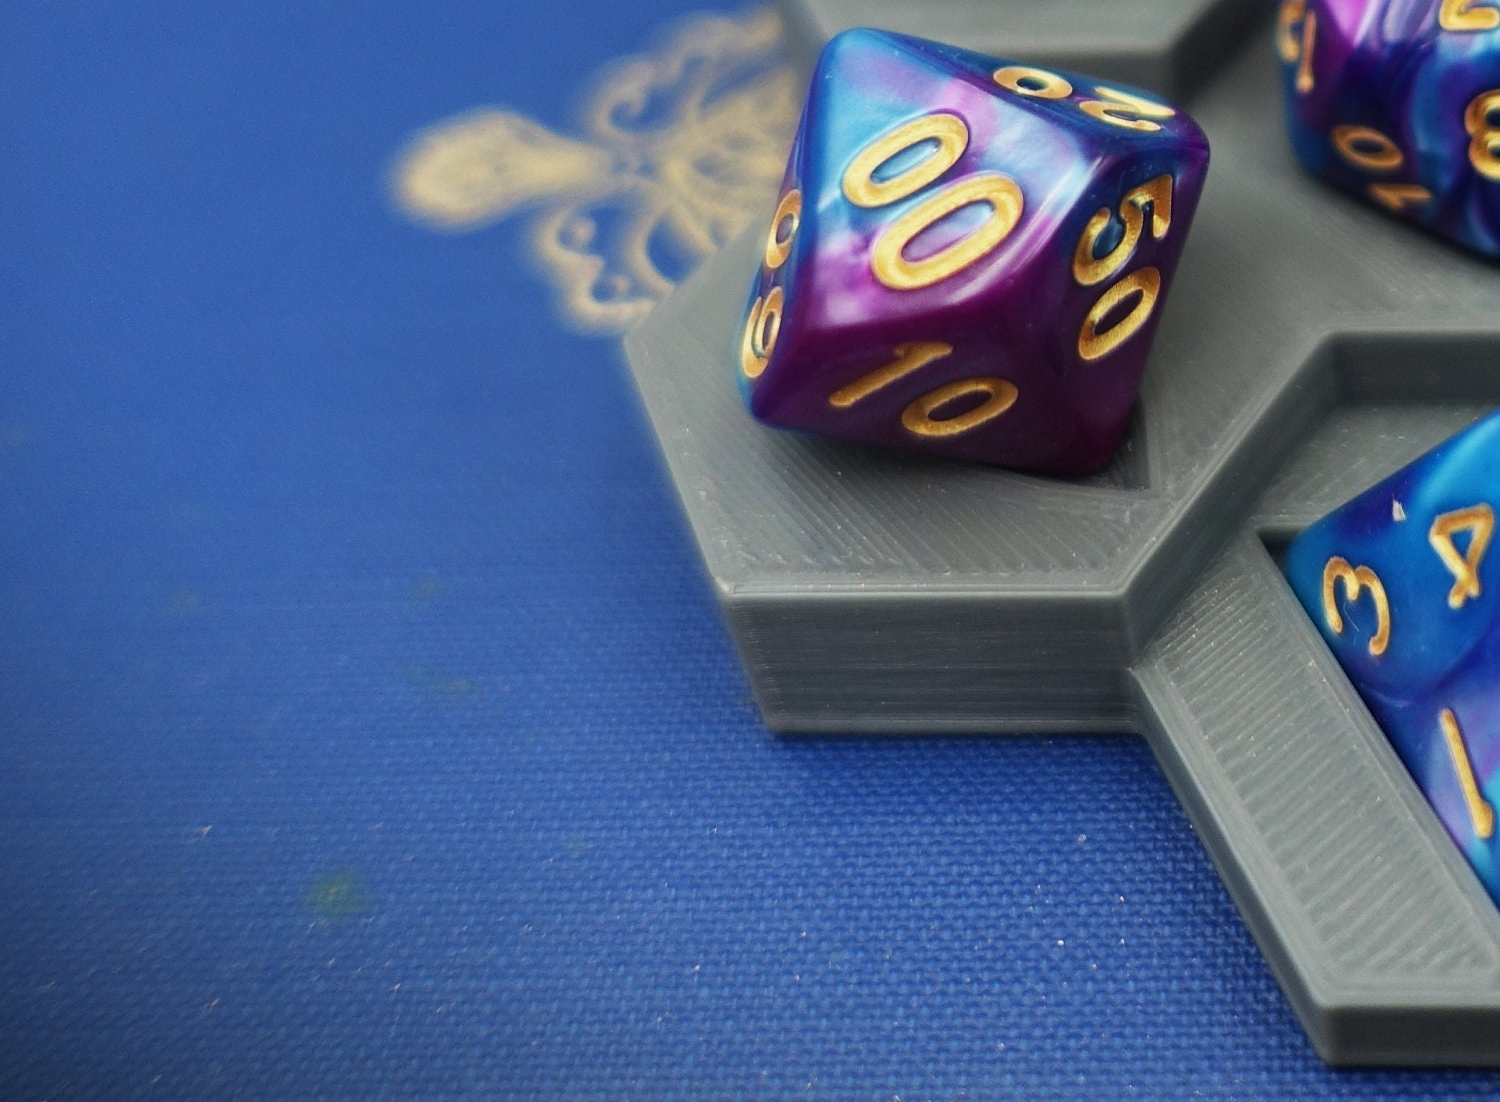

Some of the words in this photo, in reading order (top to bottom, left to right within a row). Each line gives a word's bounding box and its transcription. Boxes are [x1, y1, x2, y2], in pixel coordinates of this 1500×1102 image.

[993, 66, 1176, 132] 20
[842, 111, 1024, 291] 00
[1073, 174, 1173, 362] 50
[828, 341, 1020, 437] 10
[1323, 556, 1389, 656] 3
[1429, 503, 1494, 609] 4
[1440, 706, 1493, 838] 1
